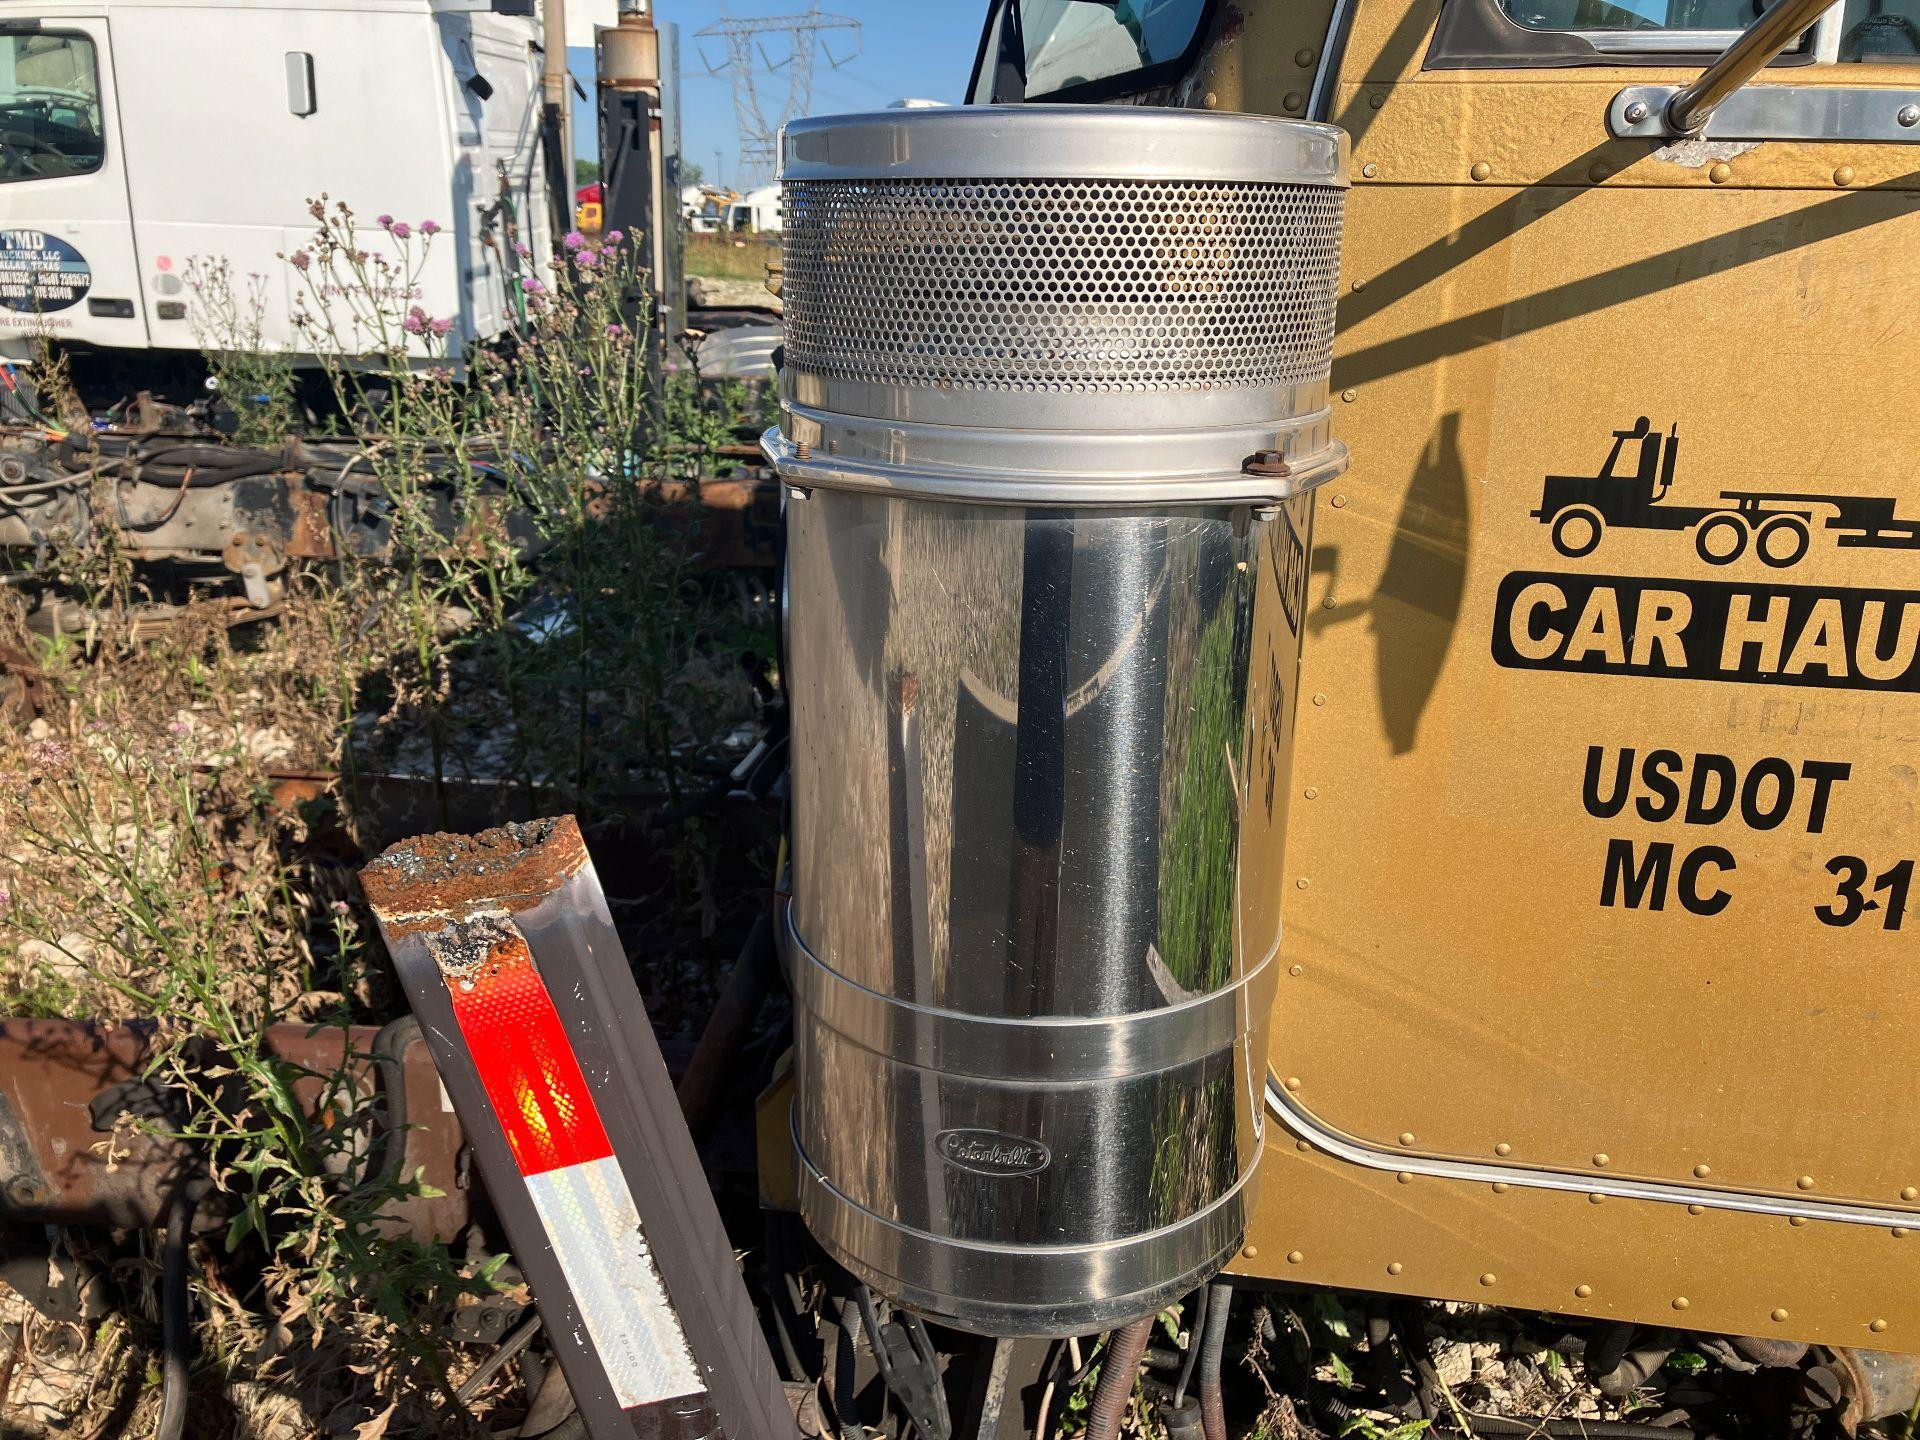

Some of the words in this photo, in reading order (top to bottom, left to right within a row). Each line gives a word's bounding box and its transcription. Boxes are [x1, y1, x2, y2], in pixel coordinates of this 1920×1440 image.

[2, 231, 45, 250] TMD
[42, 251, 61, 260] LLC
[31, 261, 60, 272] TEXAS
[1509, 583, 1694, 668] CAR
[1719, 594, 1920, 681] HAU
[1582, 745, 1852, 834] USDOT
[1599, 838, 1737, 916] MC
